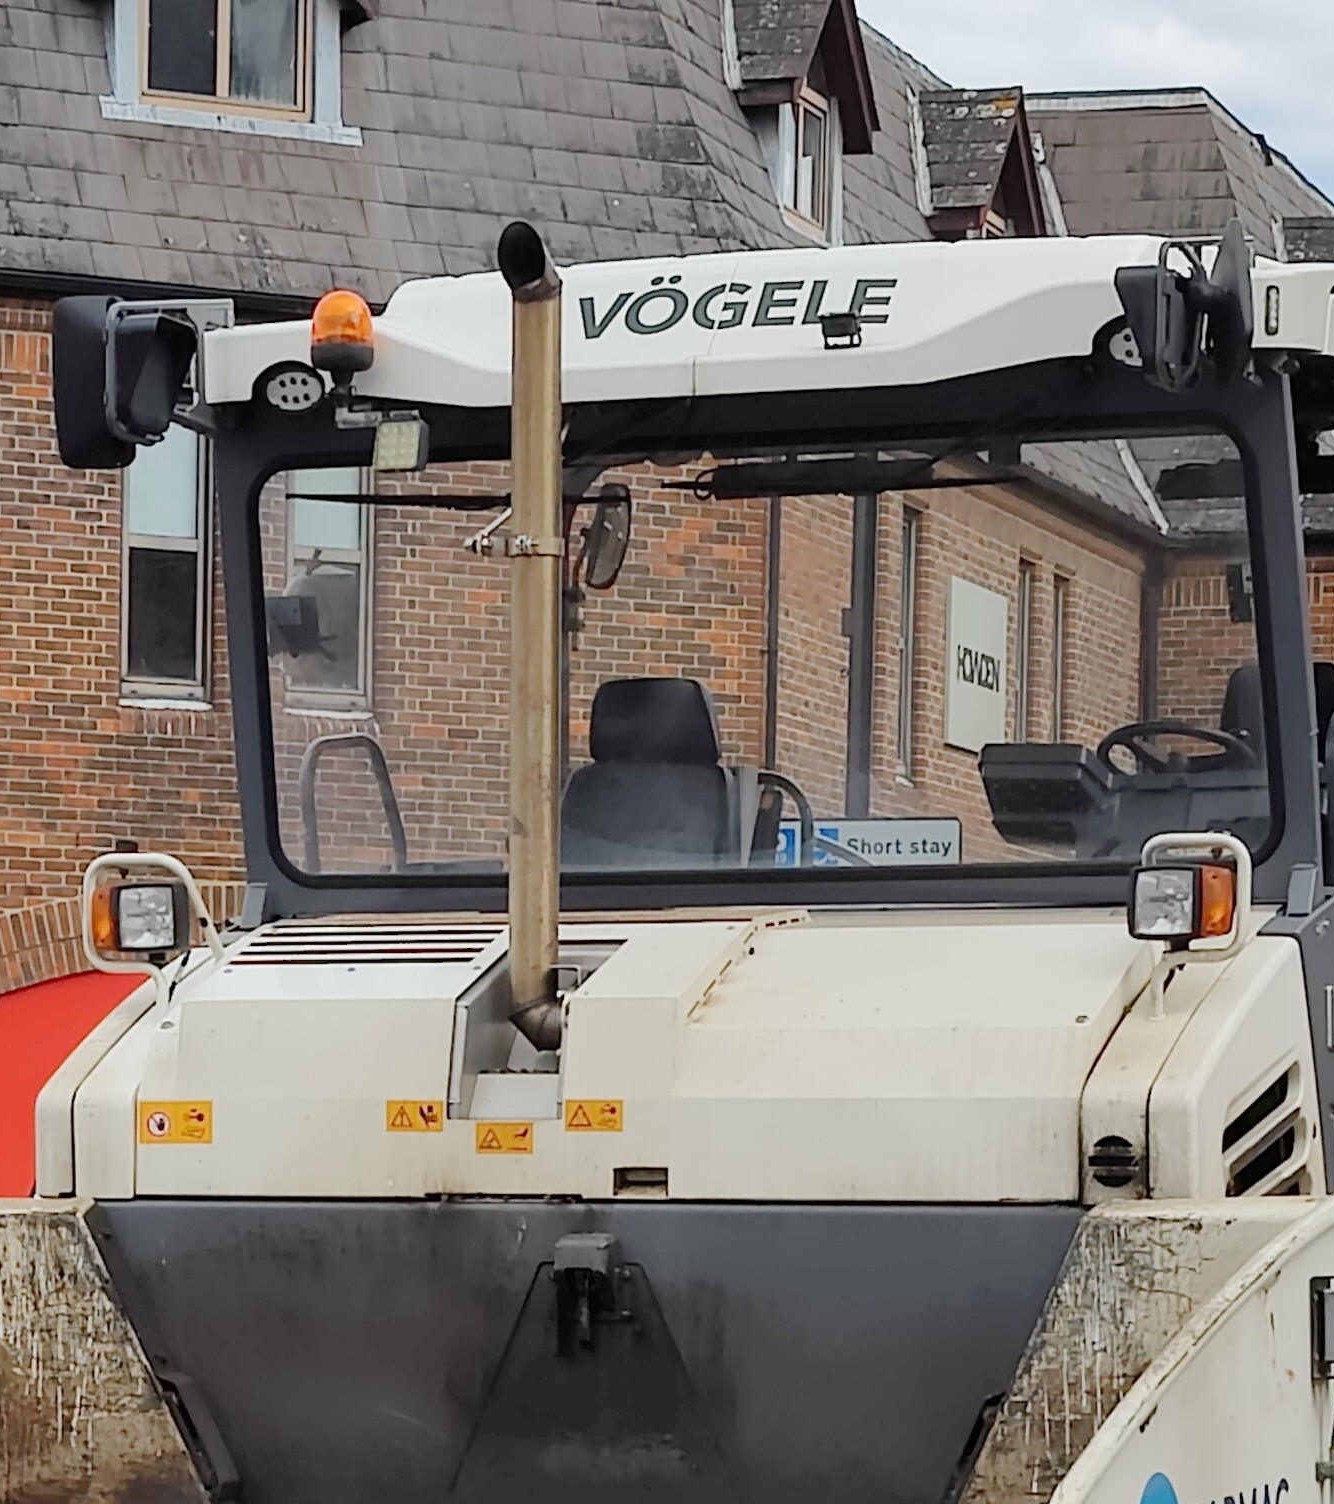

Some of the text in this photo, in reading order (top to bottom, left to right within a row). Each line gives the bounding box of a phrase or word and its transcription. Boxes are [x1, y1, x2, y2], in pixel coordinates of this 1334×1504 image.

[579, 276, 897, 339] VÖGELE
[957, 644, 1000, 693] HOWDEN
[847, 838, 952, 857] Short stay
